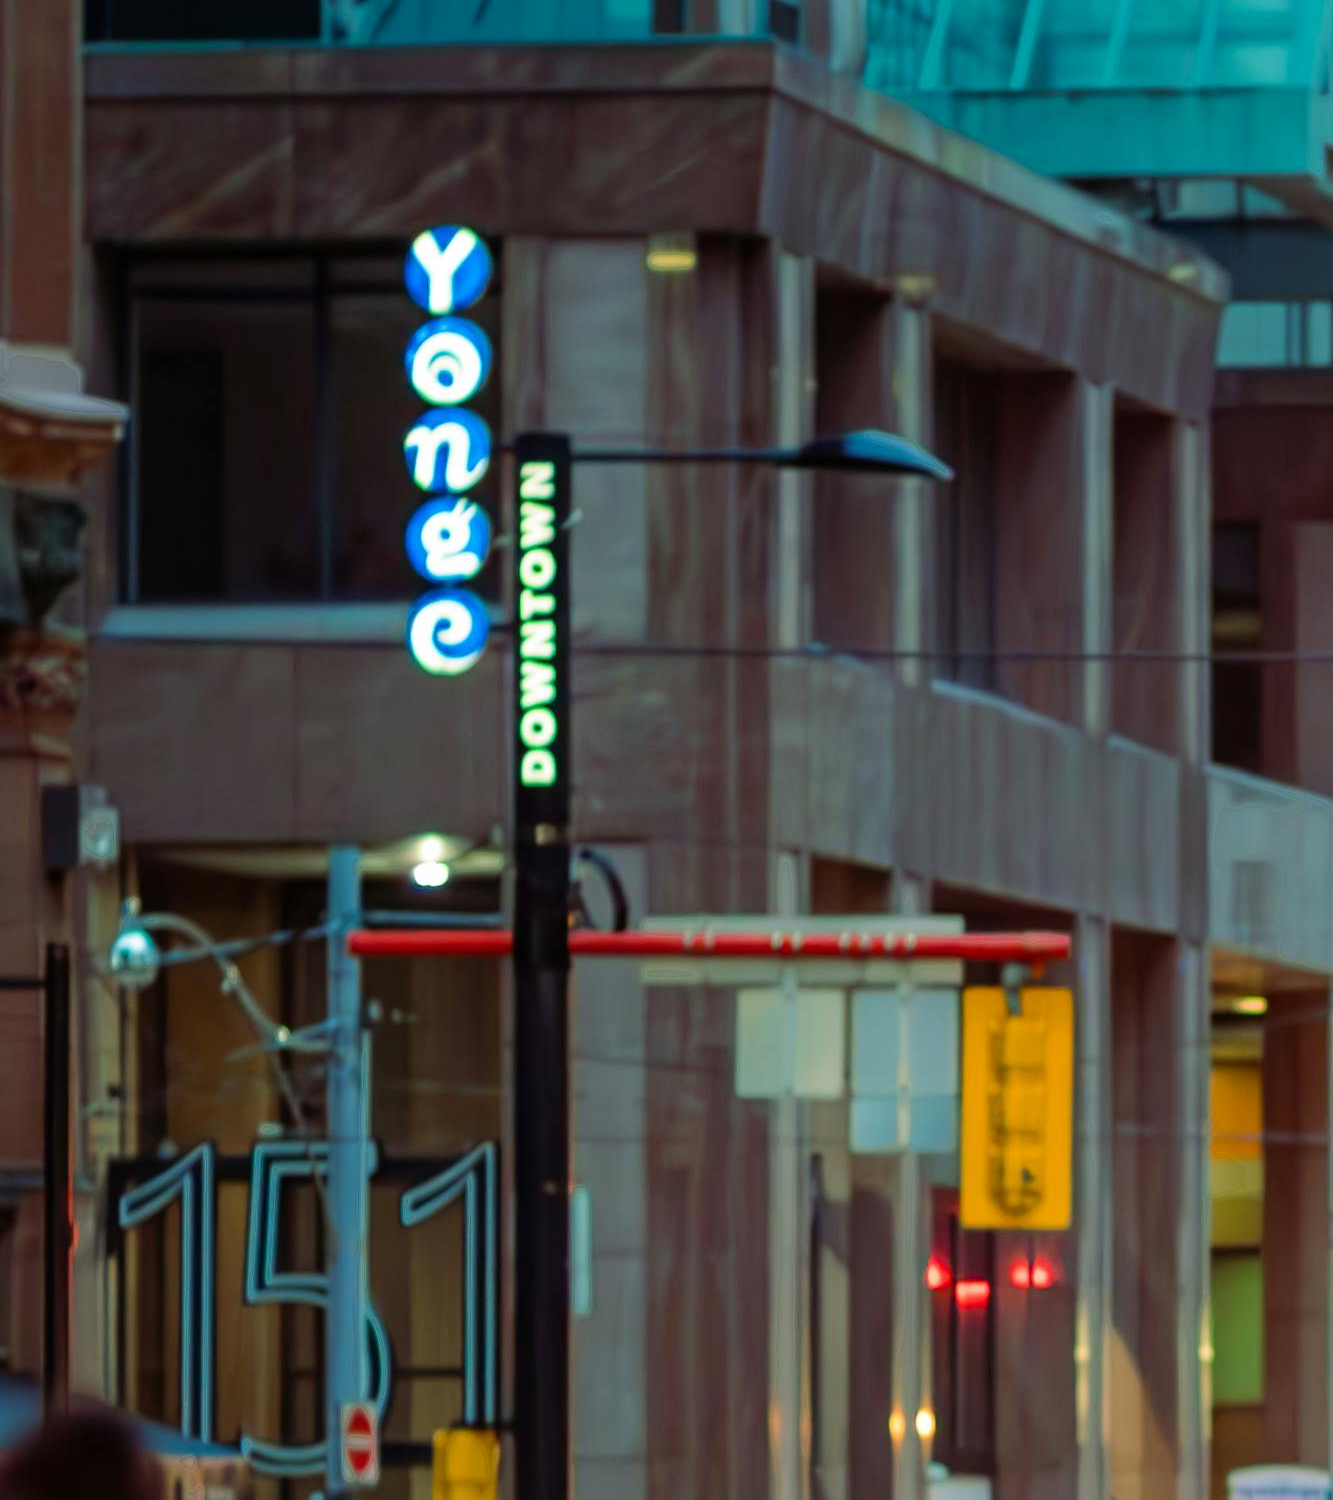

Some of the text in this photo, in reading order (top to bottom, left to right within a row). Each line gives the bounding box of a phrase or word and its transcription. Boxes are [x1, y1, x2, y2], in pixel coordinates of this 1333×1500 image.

[404, 226, 488, 674] Yonge
[520, 461, 558, 787] DOWNTOWN
[118, 1141, 495, 1474] 151
